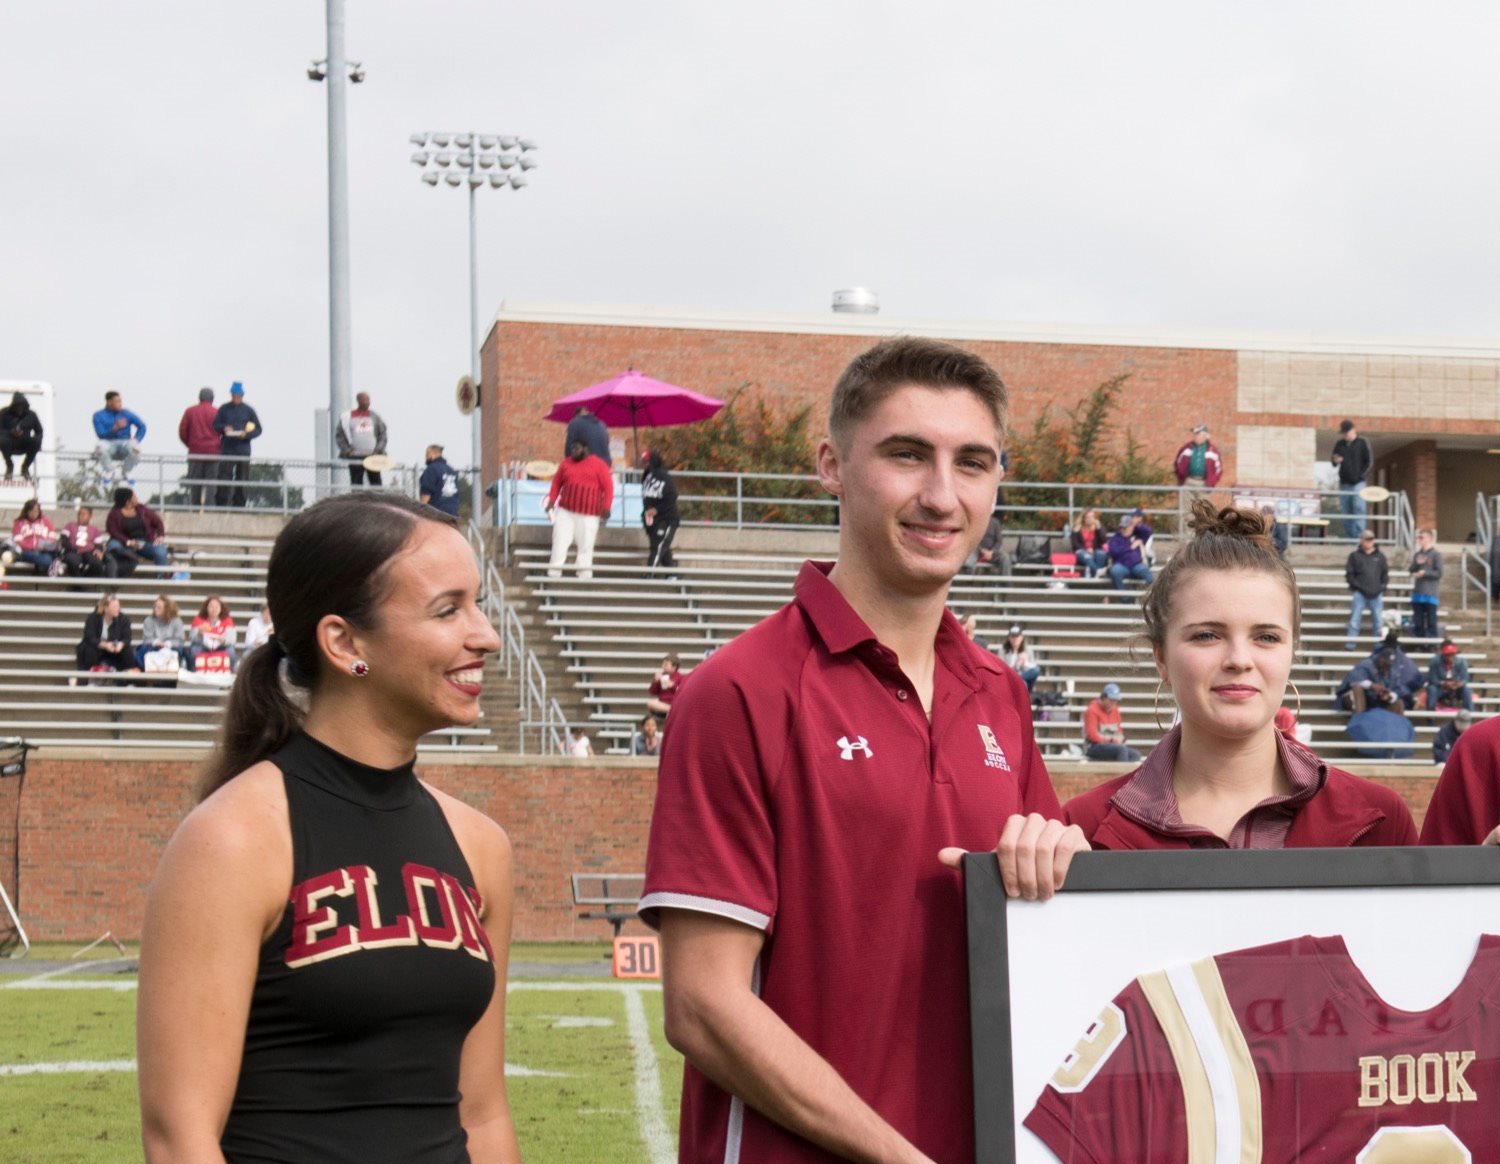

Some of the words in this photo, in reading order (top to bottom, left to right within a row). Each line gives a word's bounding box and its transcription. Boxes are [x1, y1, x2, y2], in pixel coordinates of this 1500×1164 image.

[285, 862, 495, 969] ELON
[619, 942, 656, 974] 30
[1357, 1051, 1478, 1107] BOOK
